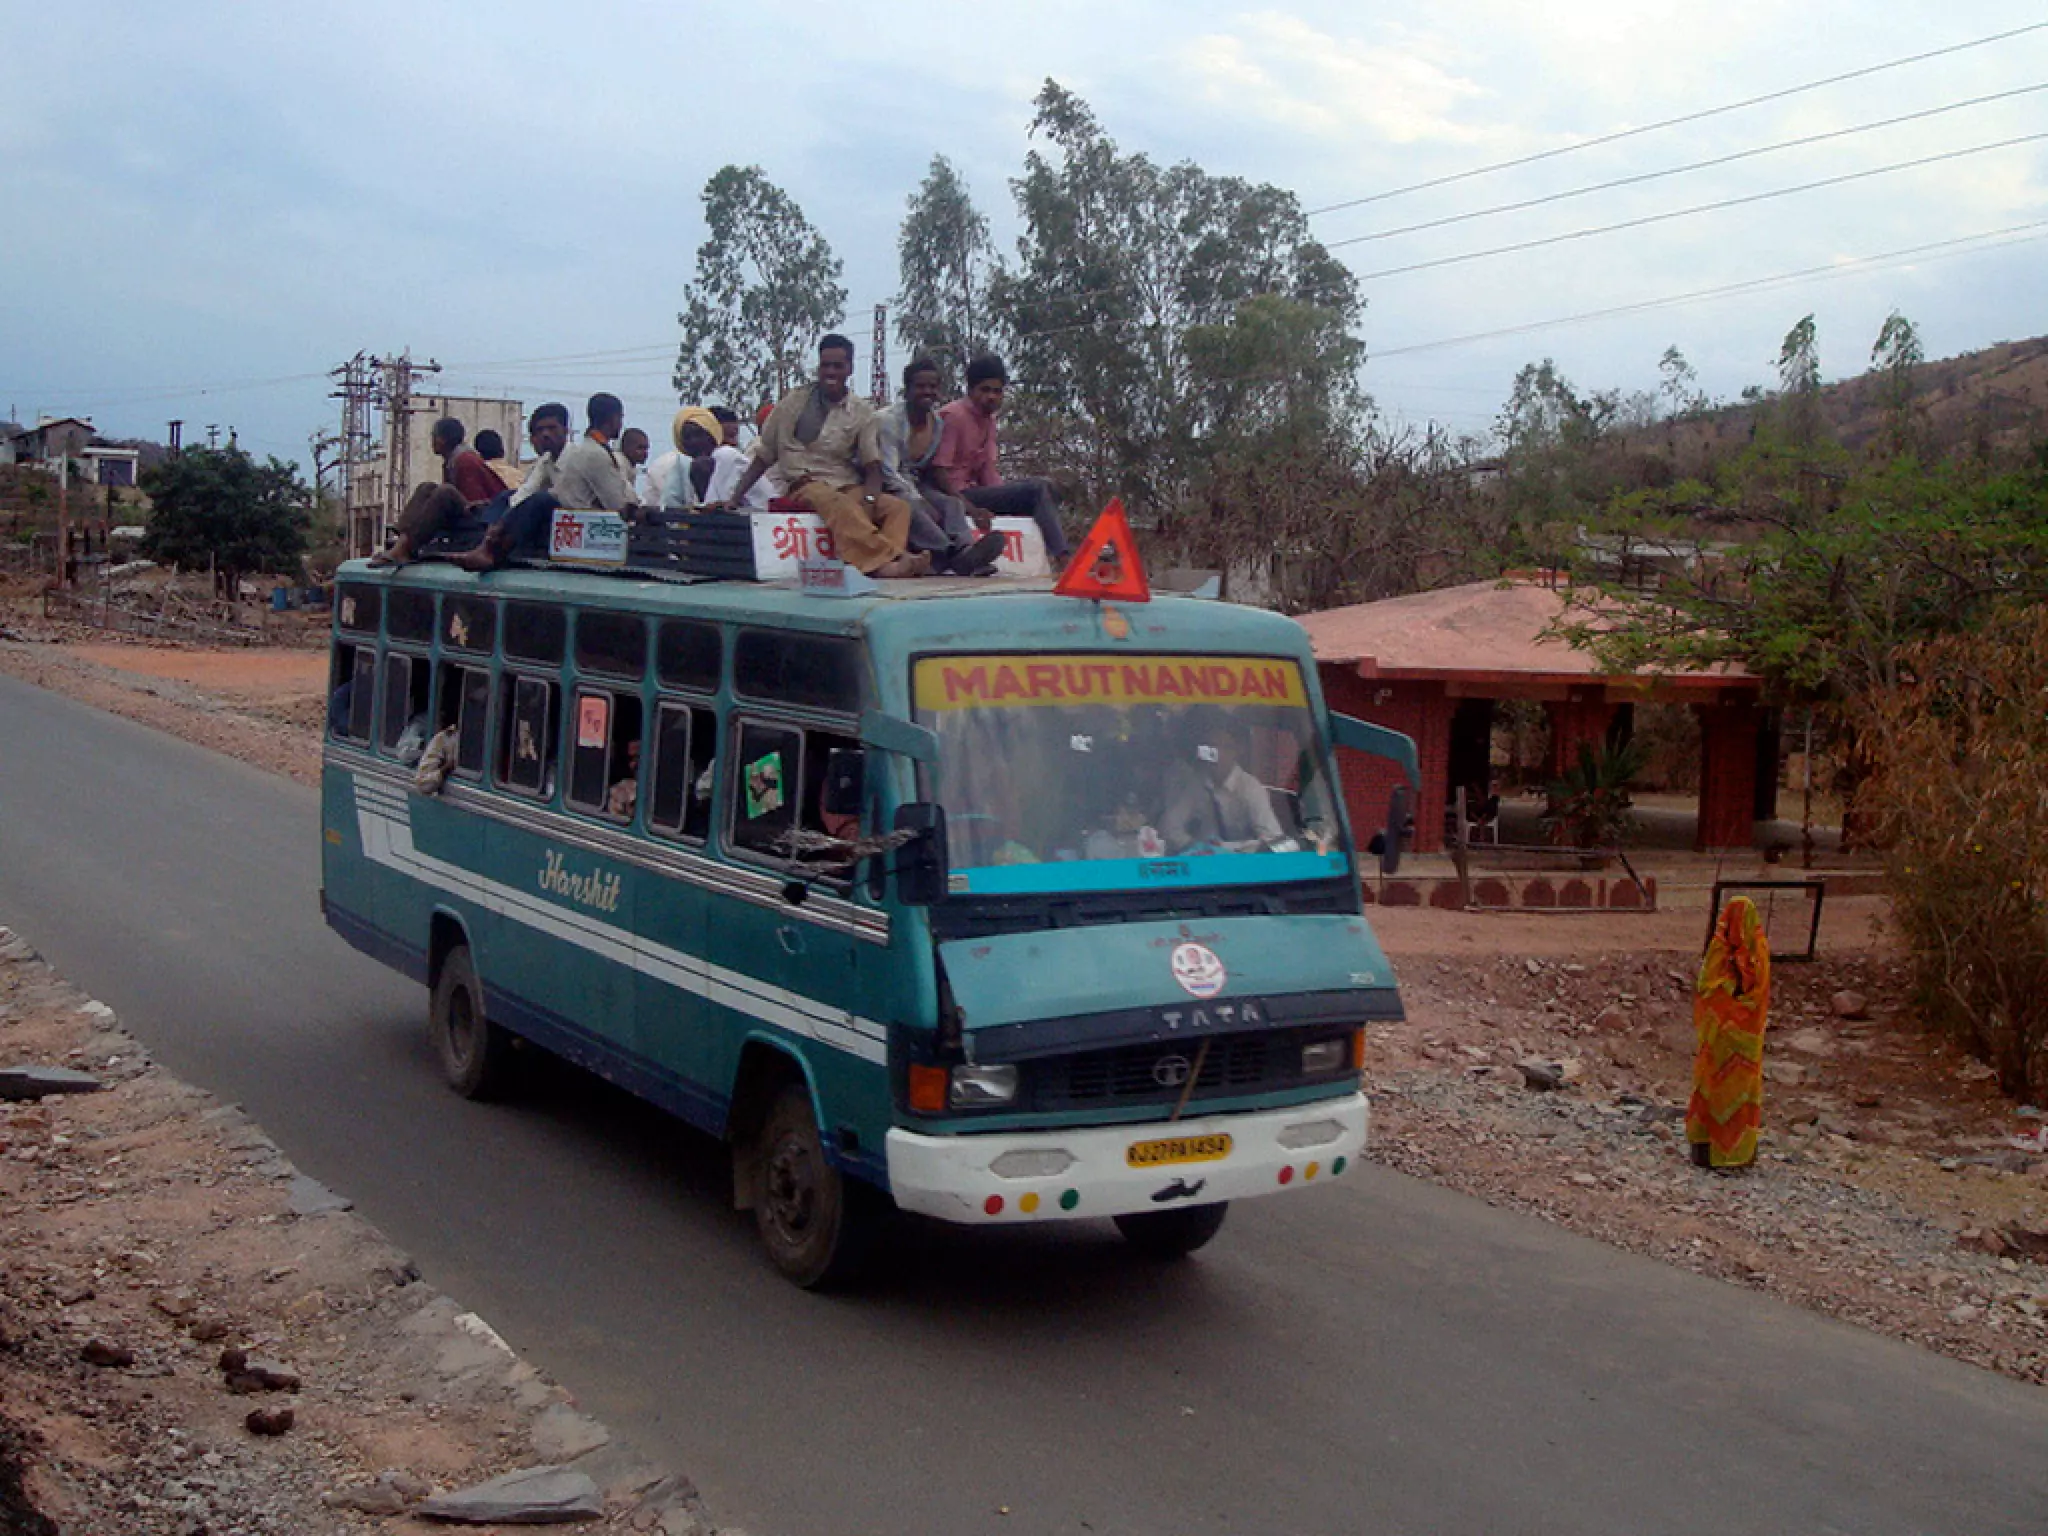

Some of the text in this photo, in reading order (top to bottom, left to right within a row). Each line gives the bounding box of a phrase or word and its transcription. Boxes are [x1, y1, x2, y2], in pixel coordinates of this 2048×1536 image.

[941, 663, 1289, 703] MARUTNANDAN
[538, 847, 621, 913] Harshit
[1162, 1003, 1260, 1029] TATA
